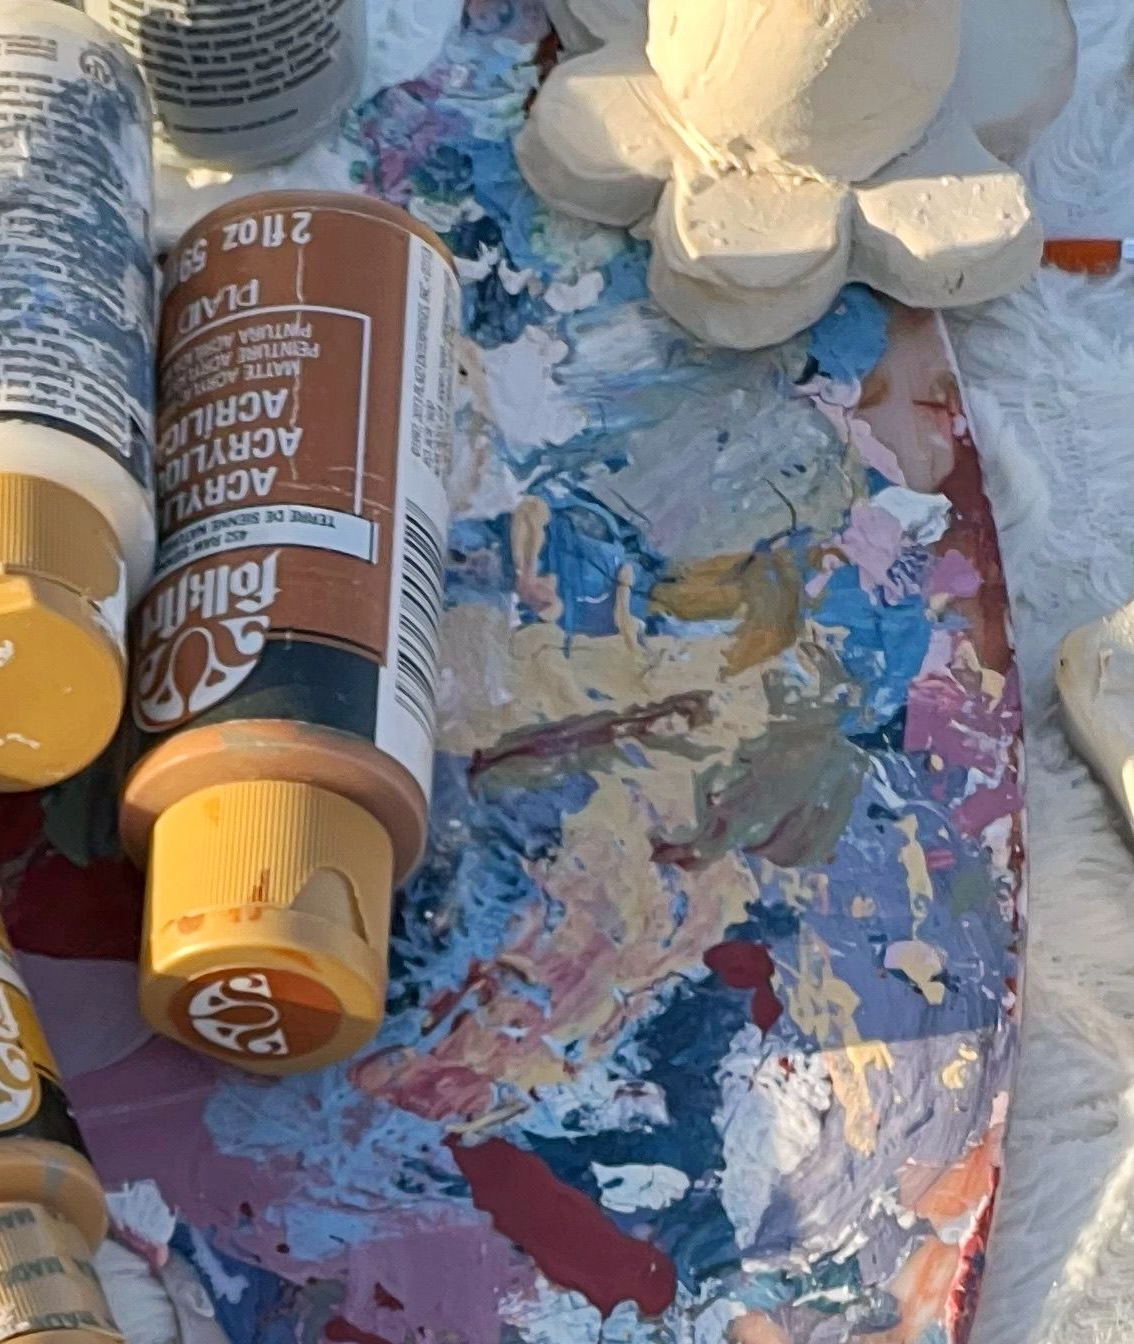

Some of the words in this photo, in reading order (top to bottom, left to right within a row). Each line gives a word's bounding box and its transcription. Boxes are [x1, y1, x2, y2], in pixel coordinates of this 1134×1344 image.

[222, 217, 259, 251] oz
[260, 213, 285, 247] fl
[289, 210, 314, 246] 2
[176, 278, 258, 334] PLAID
[243, 359, 301, 380] MATTE
